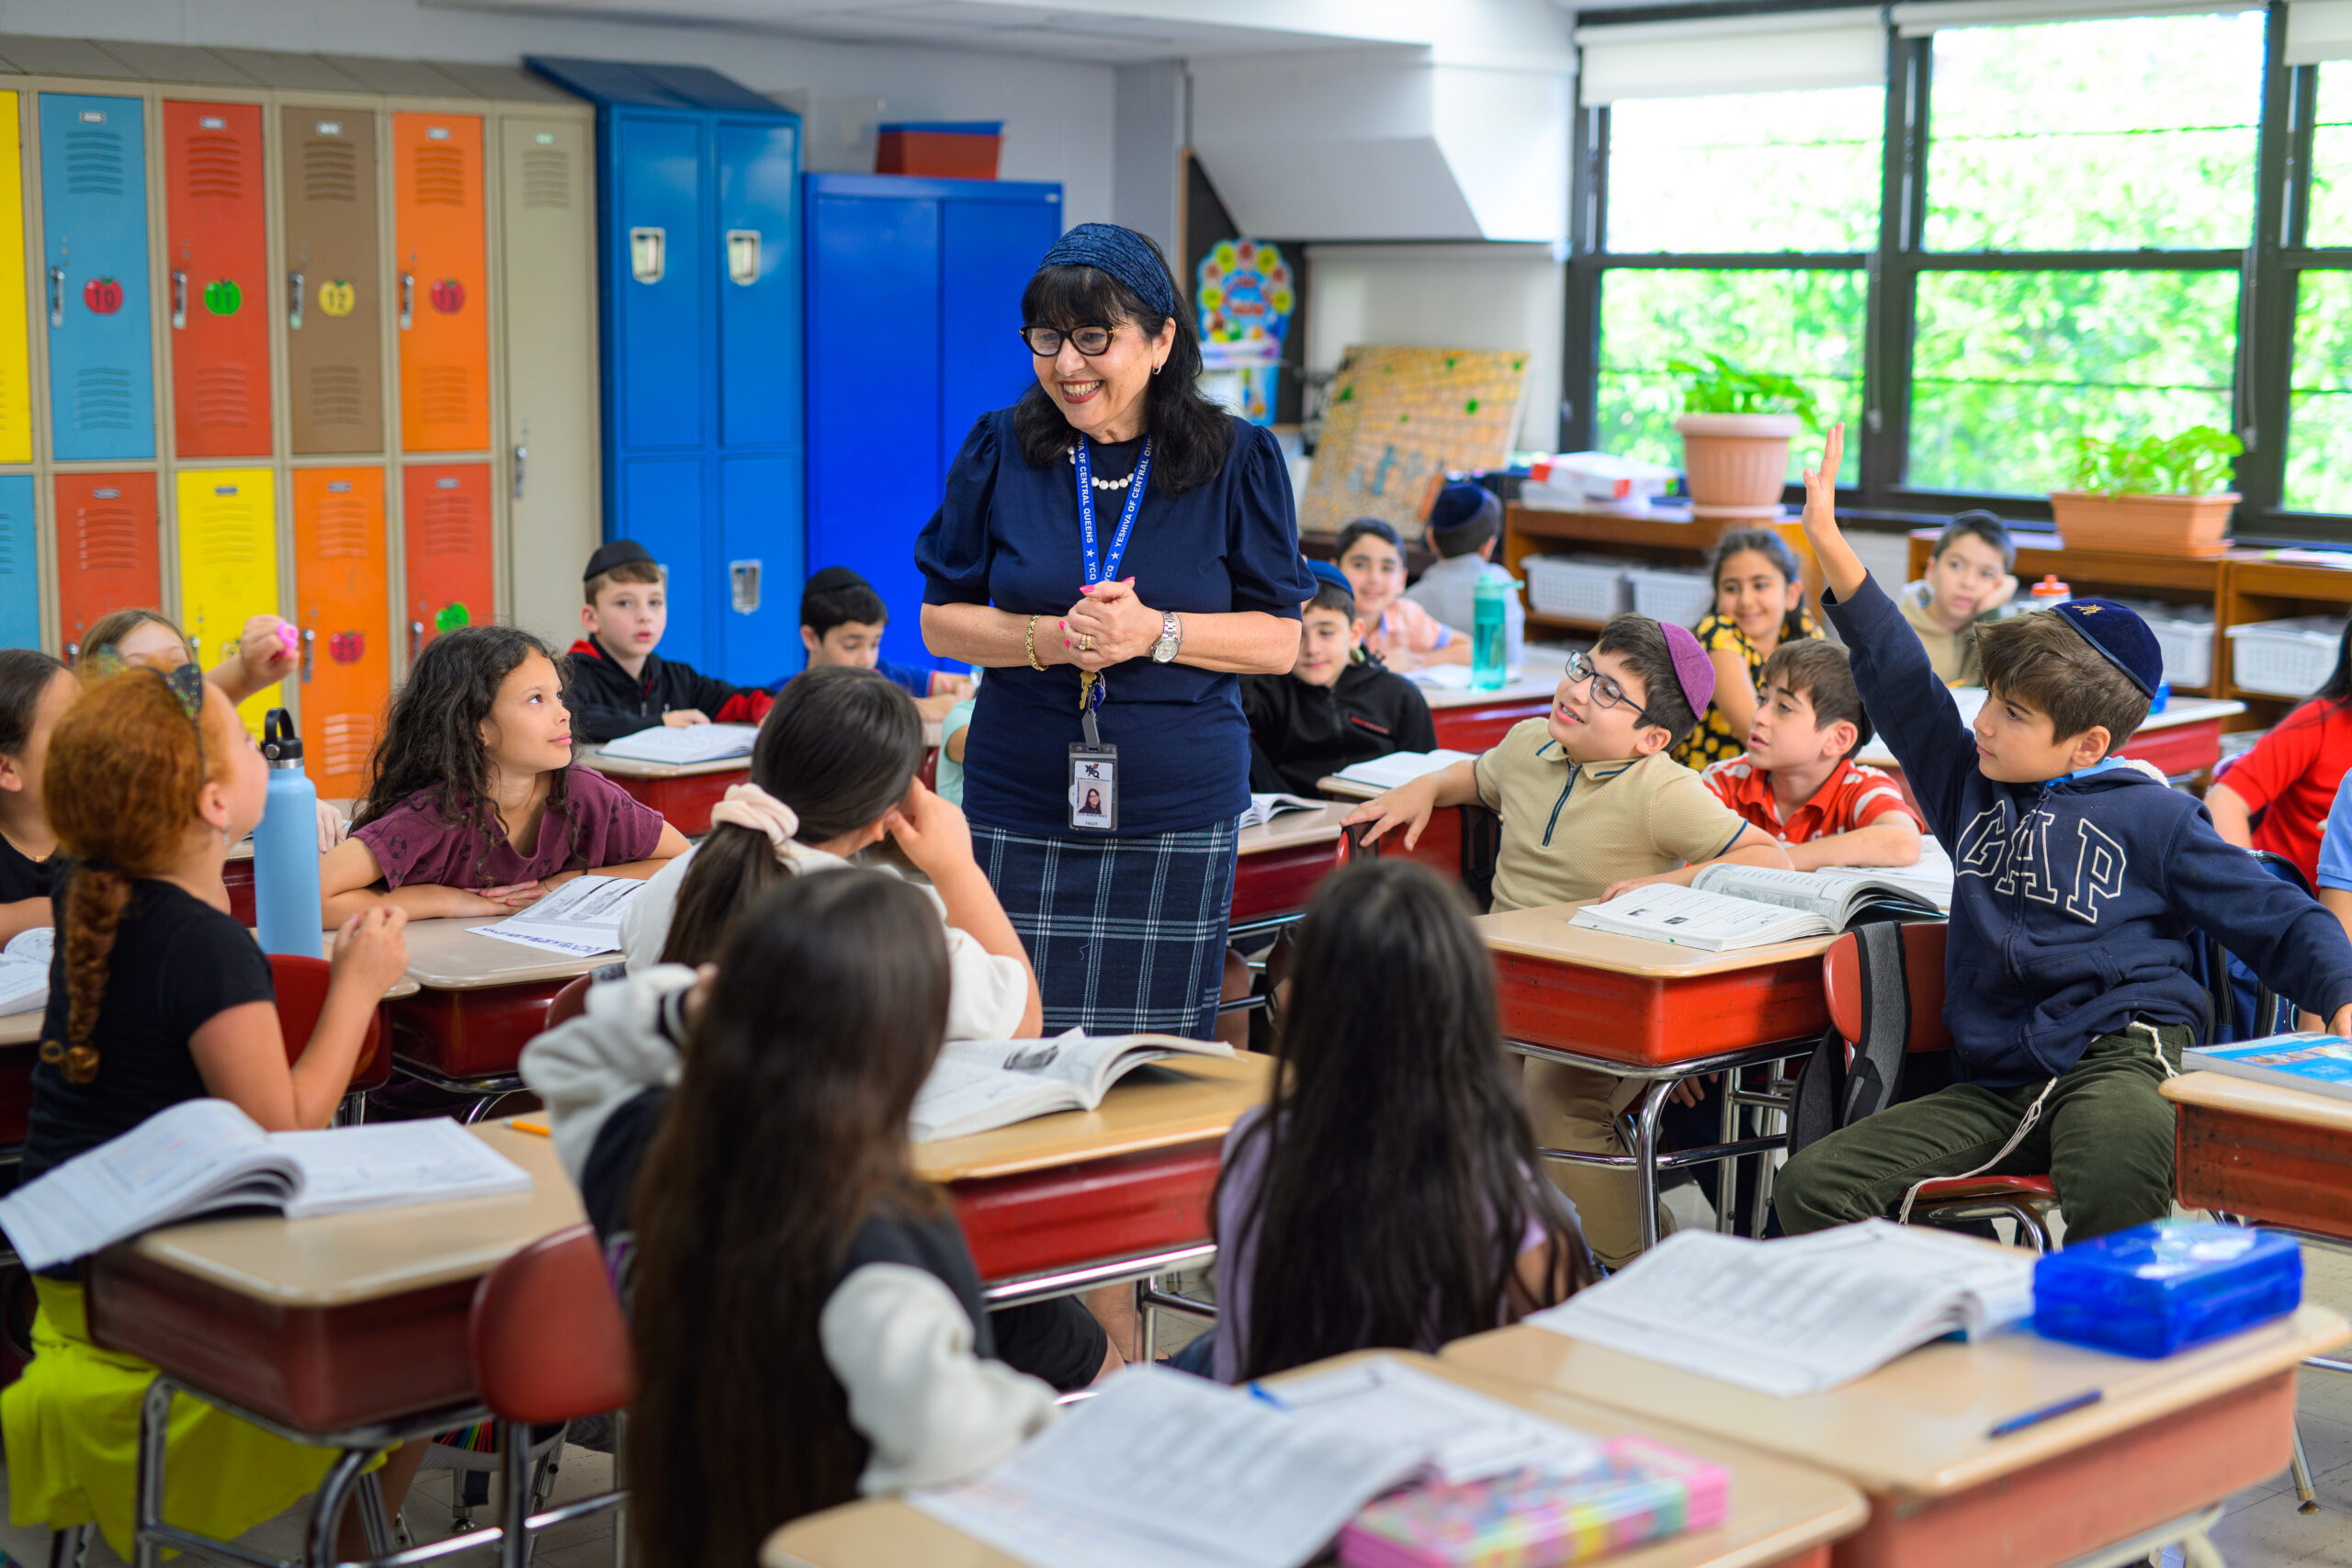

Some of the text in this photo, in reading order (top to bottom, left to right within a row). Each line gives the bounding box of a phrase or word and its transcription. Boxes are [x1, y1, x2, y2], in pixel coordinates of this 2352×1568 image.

[95, 288, 115, 310] 10
[214, 289, 232, 310] 11
[328, 289, 345, 310] 12
[1078, 452, 1086, 464] OF
[1080, 466, 1090, 506] CENTRAL
[1131, 458, 1149, 499] CENTRAL
[1127, 500, 1136, 513] OF
[1083, 507, 1093, 544] QUEENS
[1114, 513, 1133, 547] YESHIVA
[1088, 561, 1097, 581] YCQ
[1955, 799, 2127, 924] GAP
